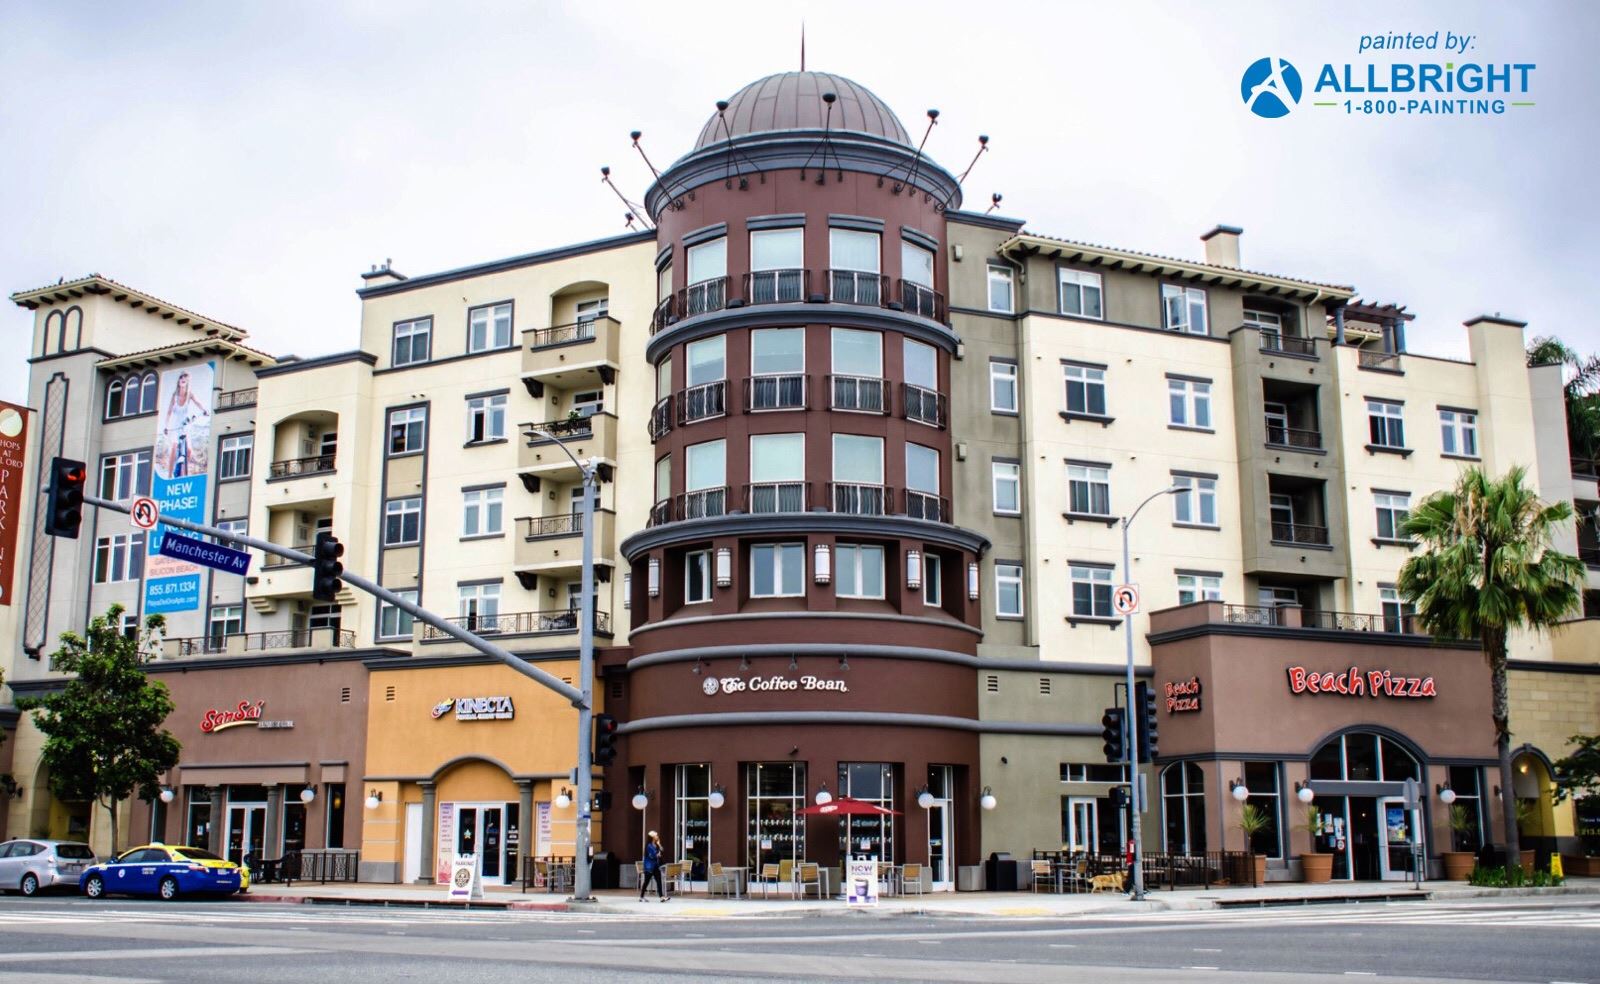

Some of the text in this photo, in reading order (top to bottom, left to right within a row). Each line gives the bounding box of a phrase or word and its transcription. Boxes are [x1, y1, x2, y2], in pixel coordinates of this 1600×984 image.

[3, 450, 12, 458] AT
[5, 458, 23, 468] ORO
[166, 482, 192, 496] NEW
[159, 496, 198, 512] PHASE!
[166, 538, 230, 564] Manchester
[231, 555, 246, 569] Av
[149, 581, 196, 596] 855.871.1334
[720, 677, 746, 694] The
[749, 676, 798, 691] Coffee
[800, 675, 848, 693] Bean
[1164, 677, 1199, 697] Beach
[1288, 666, 1437, 697] Beach Pizza
[456, 696, 514, 713] KINECTA
[1166, 697, 1199, 712] Pizza
